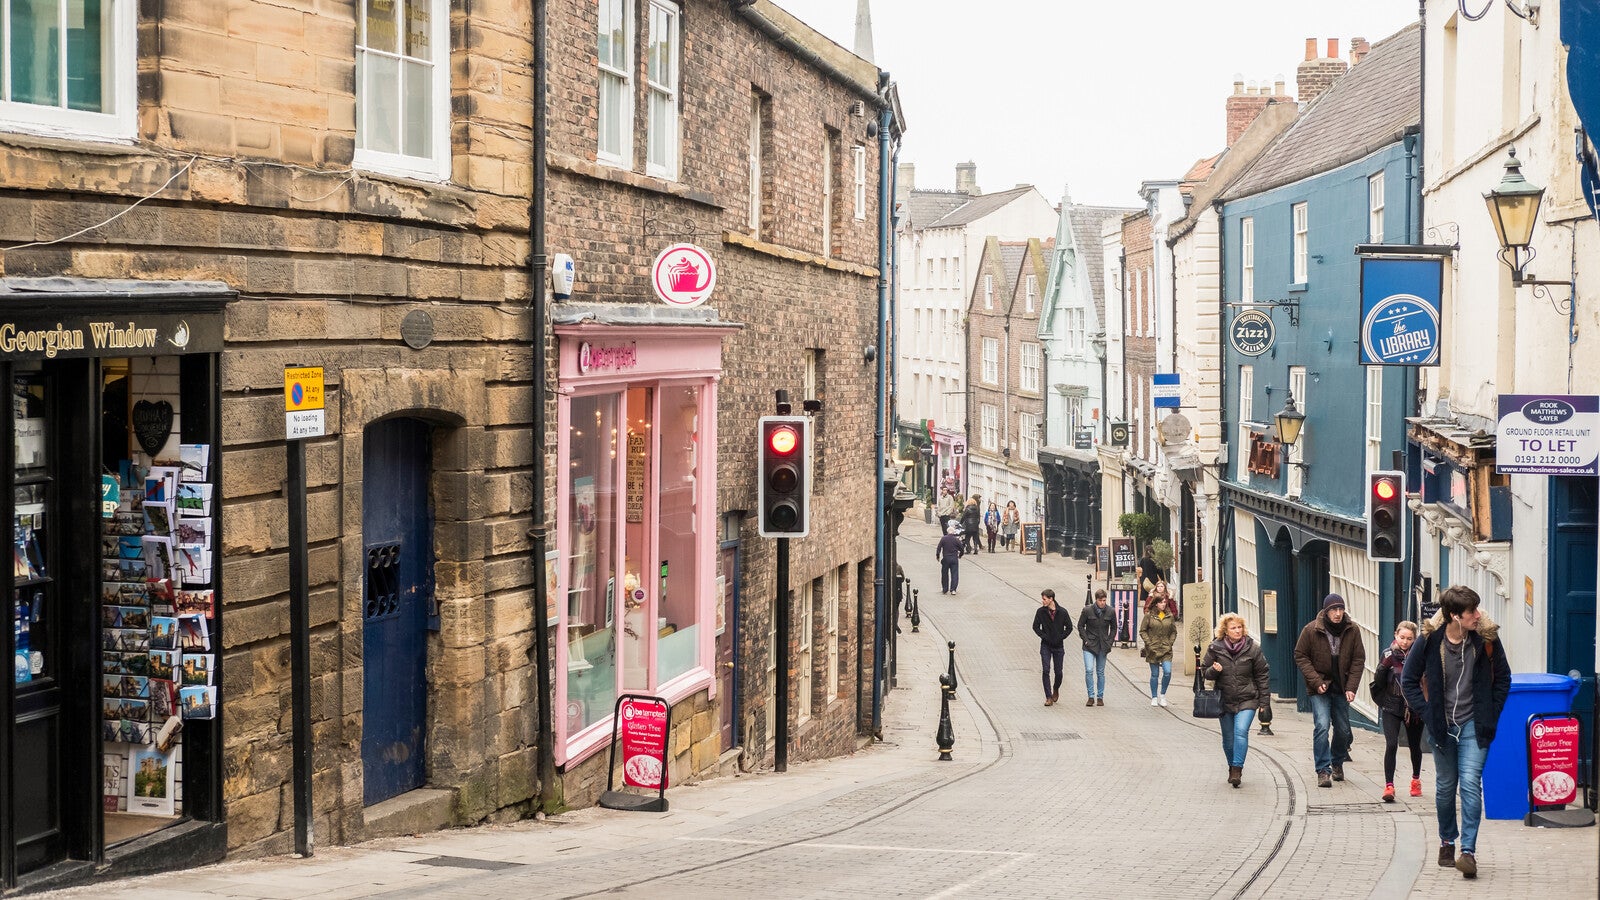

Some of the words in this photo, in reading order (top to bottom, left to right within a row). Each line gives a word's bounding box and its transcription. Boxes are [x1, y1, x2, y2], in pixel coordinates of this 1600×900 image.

[1236, 328, 1268, 338] Zizzi
[0, 323, 84, 358] Georgian
[90, 322, 157, 348] Window
[1380, 329, 1431, 355] LIBRARY
[1239, 342, 1266, 352] ITALIAN
[312, 370, 322, 378] Zone
[1519, 440, 1542, 452] TO
[1548, 440, 1577, 452] LET
[1515, 455, 1536, 463] 0191
[643, 710, 667, 718] tempted
[628, 721, 646, 730] Gluten
[1554, 725, 1578, 733] tempted
[1537, 740, 1557, 749] Gluten
